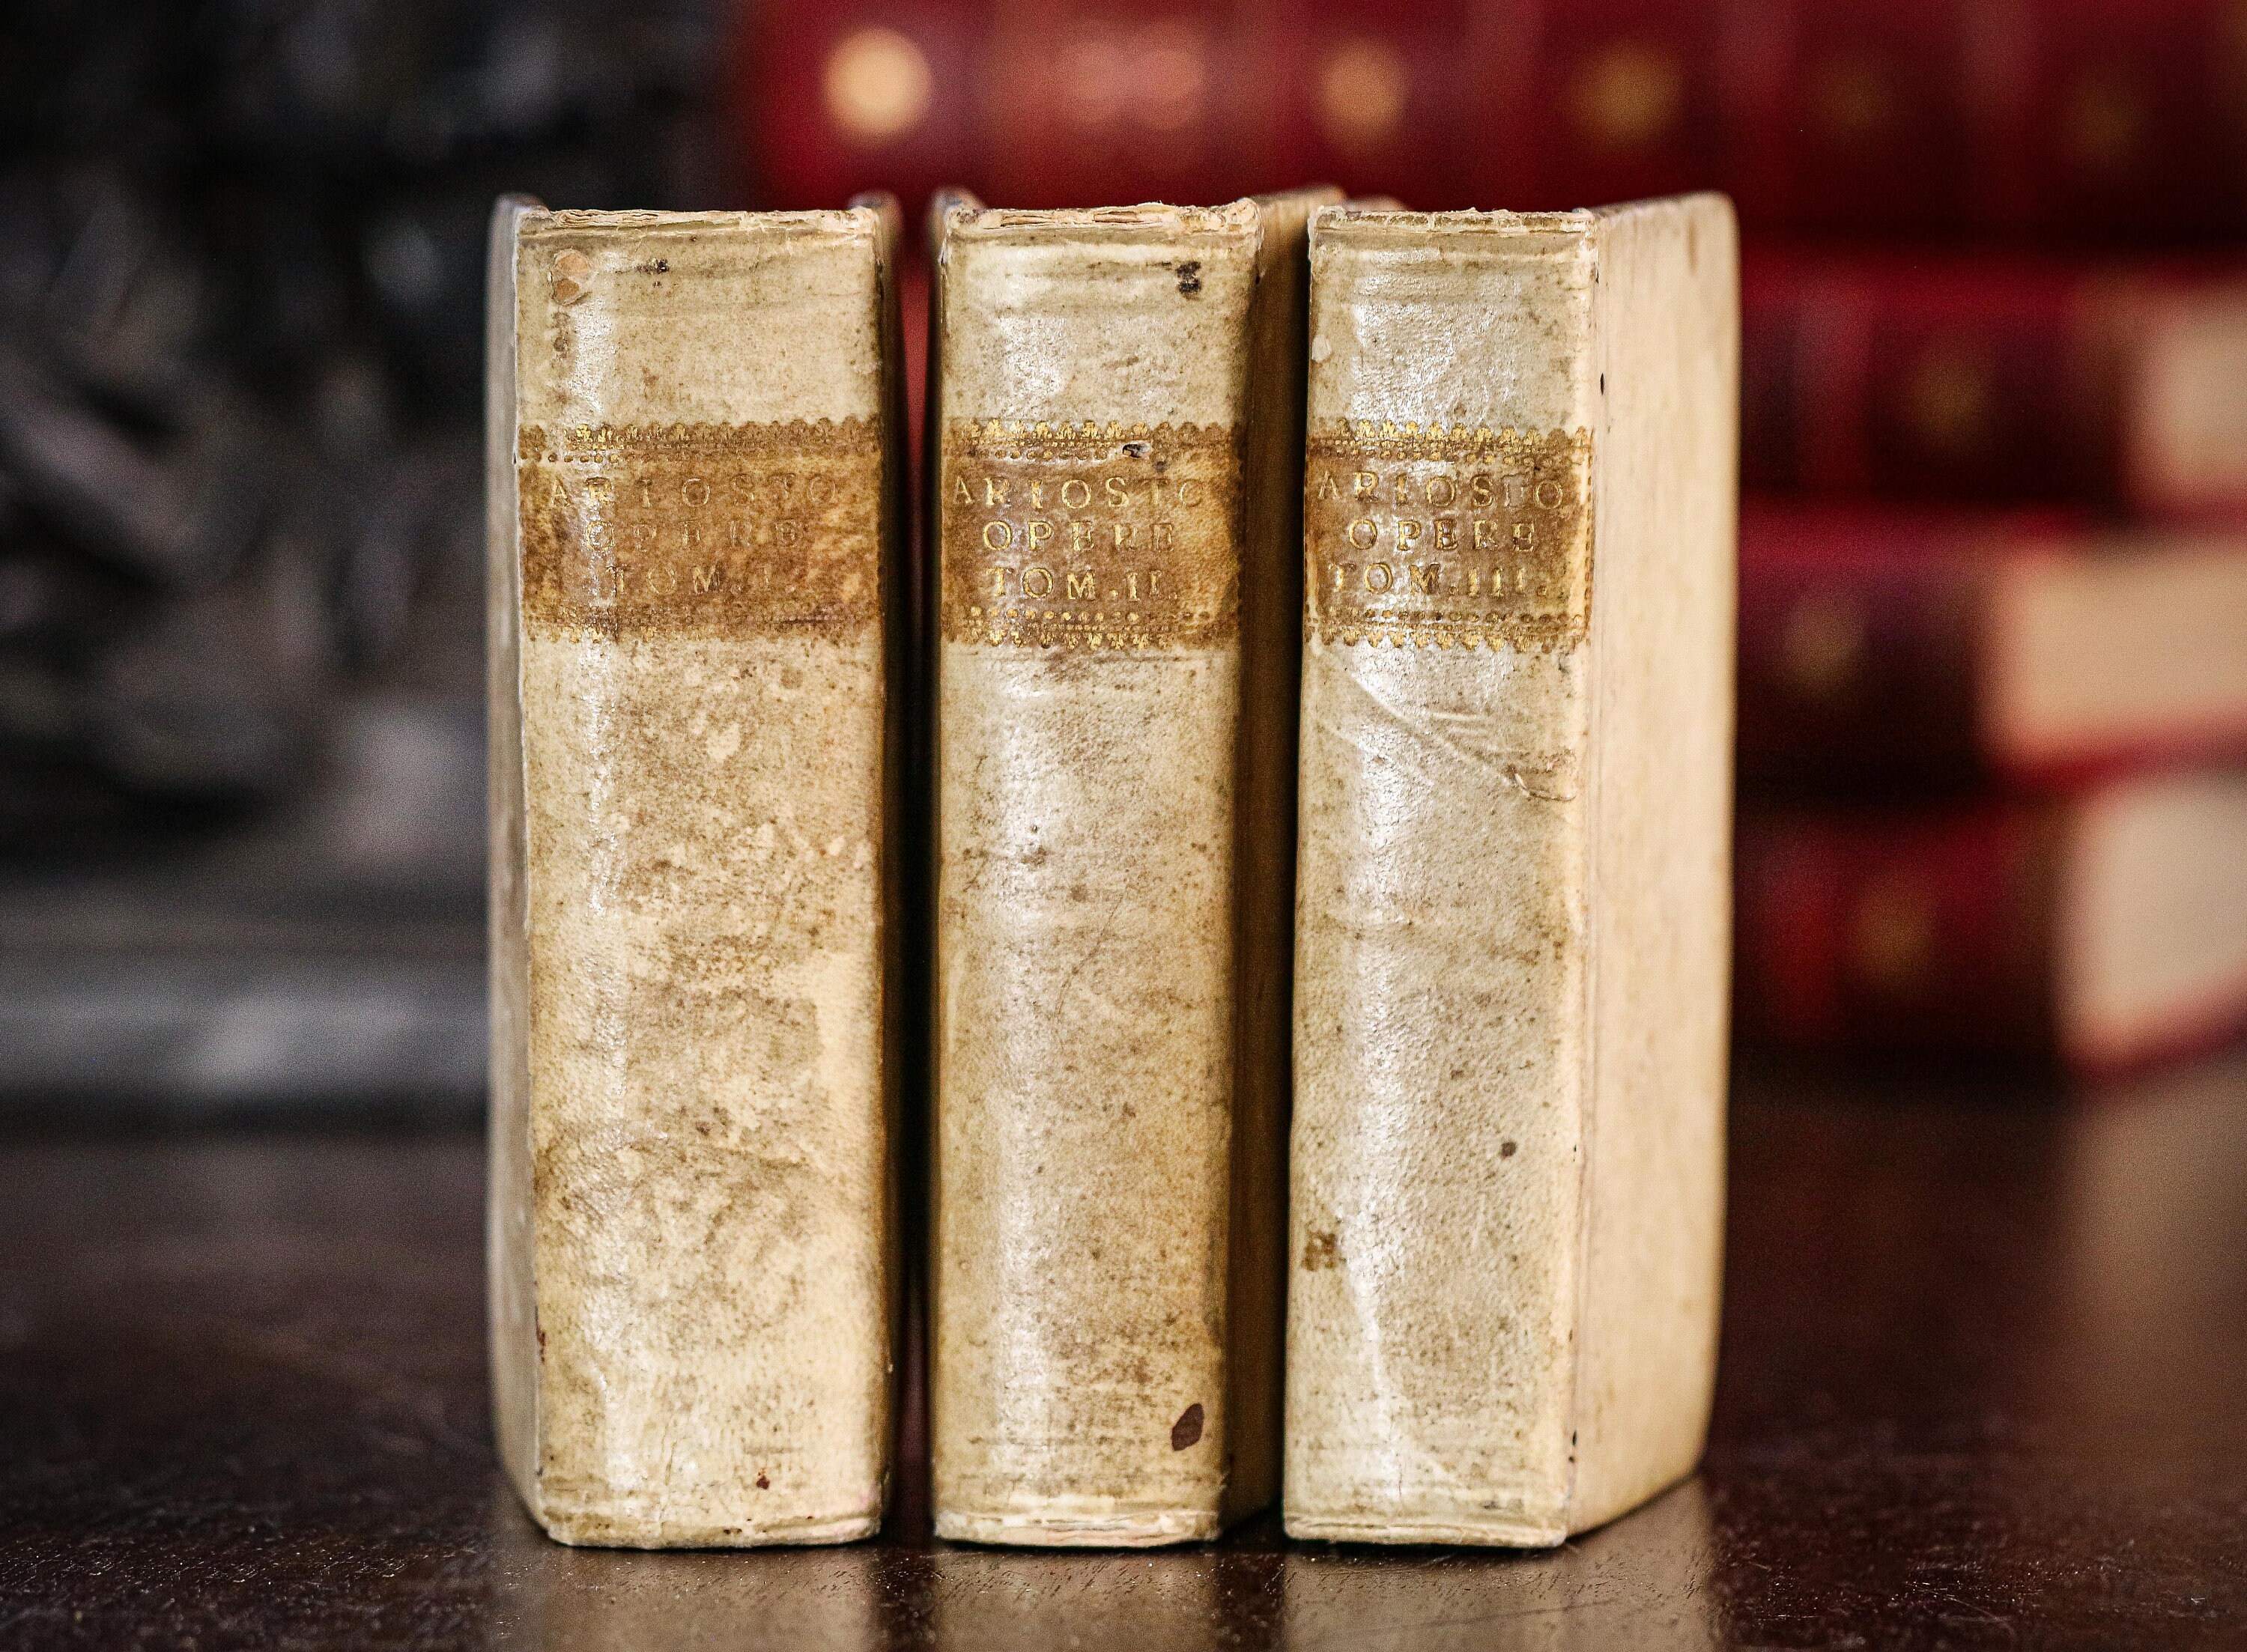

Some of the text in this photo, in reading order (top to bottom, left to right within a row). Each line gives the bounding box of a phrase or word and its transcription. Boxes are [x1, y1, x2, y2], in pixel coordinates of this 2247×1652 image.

[953, 474, 1206, 509] ARIOSTO
[1317, 470, 1564, 508] ARIOSTO
[1348, 518, 1535, 553] OPERE
